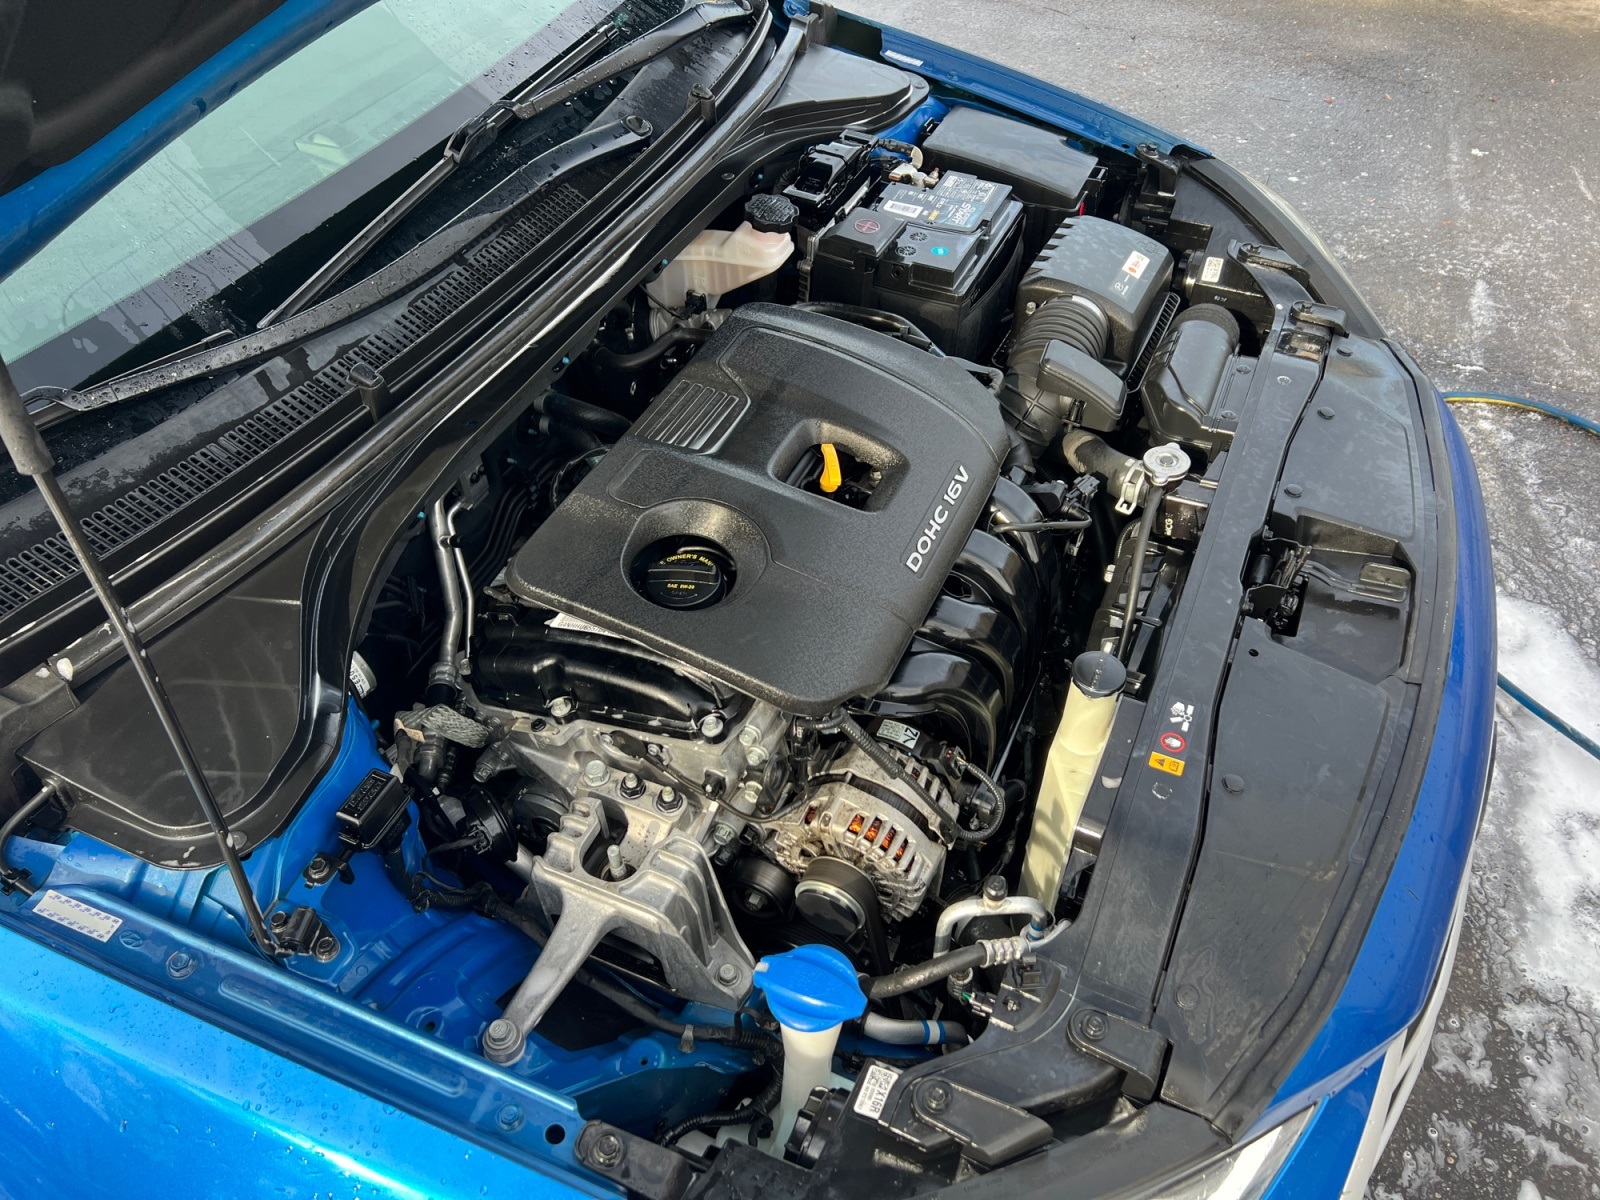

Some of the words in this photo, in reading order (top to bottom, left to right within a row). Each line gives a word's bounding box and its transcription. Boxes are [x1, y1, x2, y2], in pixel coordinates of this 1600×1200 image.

[951, 201, 971, 224] START
[905, 504, 949, 573] DOHC
[943, 465, 969, 506] 16V
[666, 553, 698, 563] OWNER'S
